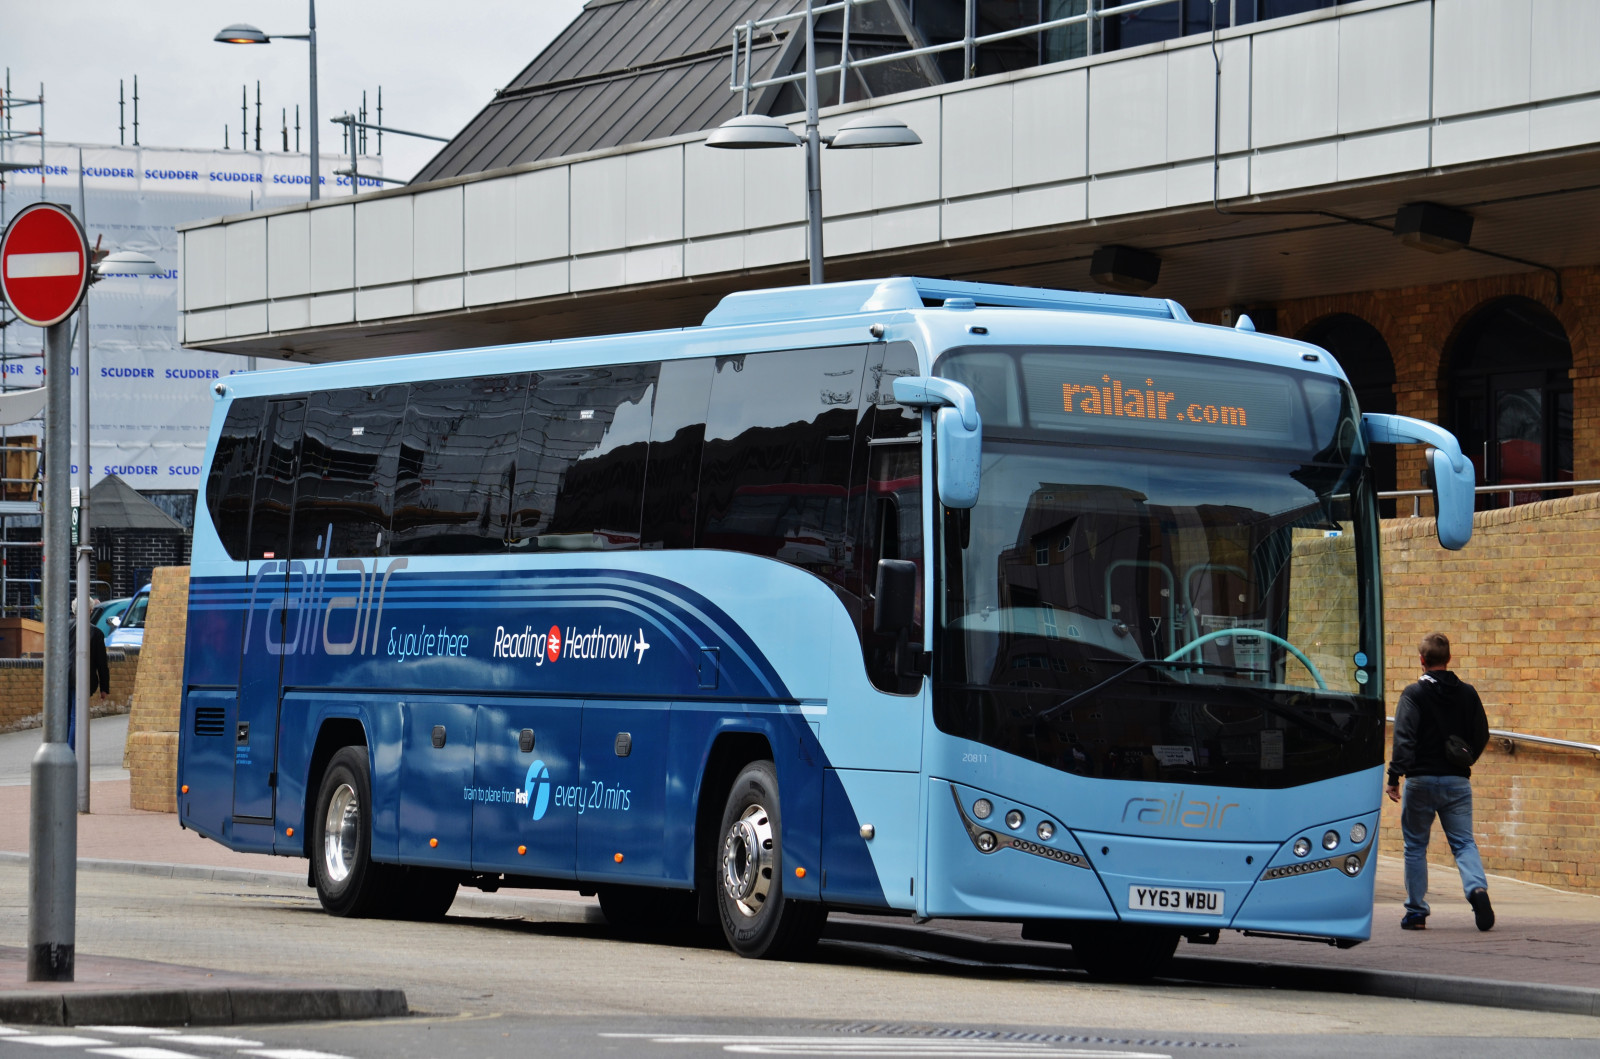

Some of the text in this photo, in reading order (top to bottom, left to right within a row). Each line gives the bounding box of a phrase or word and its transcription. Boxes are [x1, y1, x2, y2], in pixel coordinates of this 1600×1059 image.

[144, 169, 199, 180] SCUDDER
[209, 171, 263, 183] SCUDDER
[273, 174, 326, 185] SCUDDR
[101, 367, 154, 378] SCUDDER
[165, 368, 219, 379] SCUDDER
[1062, 374, 1247, 426] railair.com
[104, 465, 158, 476] SCUDDER
[243, 522, 409, 655] railair
[387, 624, 469, 663] & you're there
[493, 625, 633, 667] Reading Heathrow
[962, 753, 988, 763] 20811
[463, 785, 528, 804] train to plane from First
[554, 781, 632, 815] every 20 mins
[1121, 790, 1239, 829] railair
[1137, 888, 1217, 910] YY63 WBU
